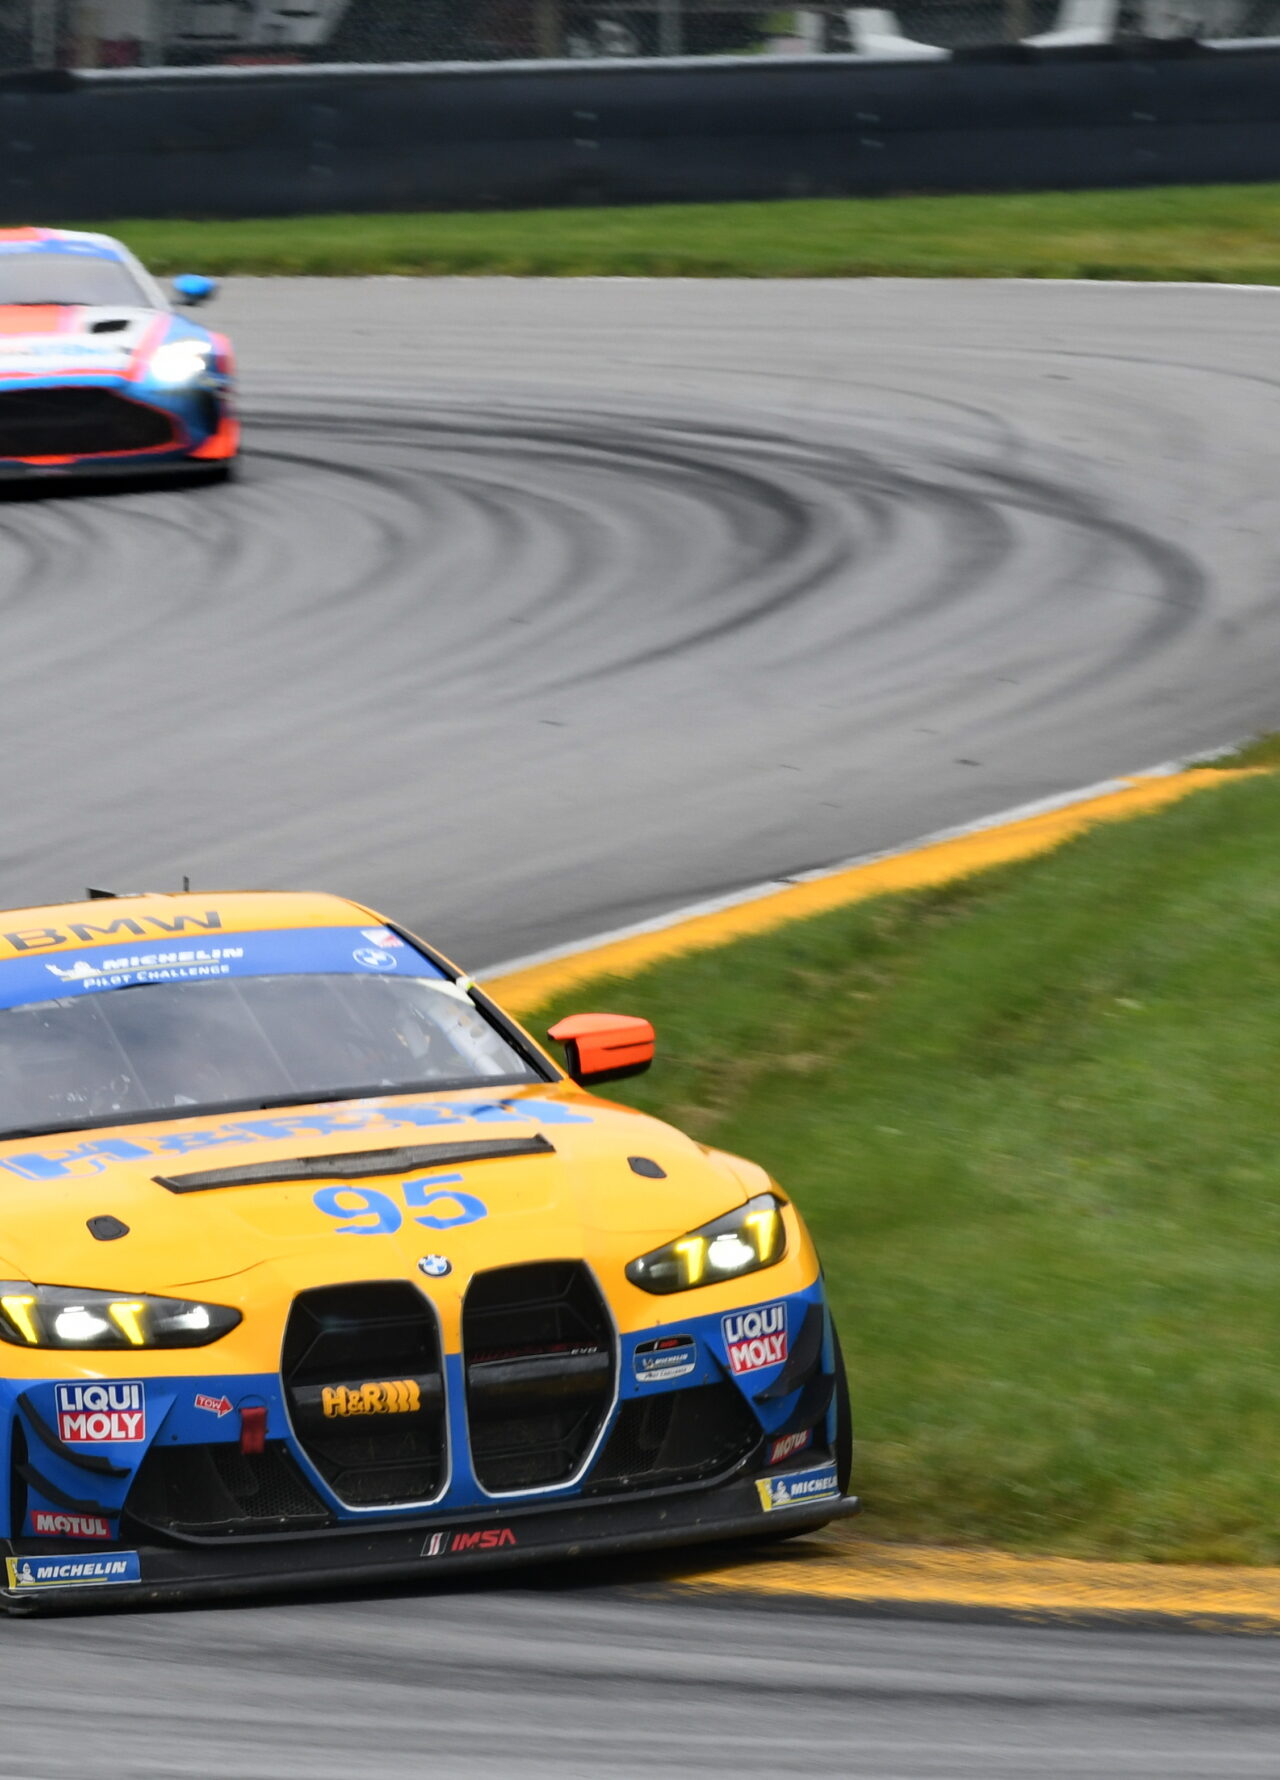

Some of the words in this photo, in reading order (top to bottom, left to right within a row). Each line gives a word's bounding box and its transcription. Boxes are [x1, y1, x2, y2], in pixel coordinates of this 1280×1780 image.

[4, 911, 222, 951] BMW
[102, 947, 243, 970] MICHELIN
[83, 974, 132, 989] PILOT
[136, 964, 230, 982] CHALLENGE
[313, 1173, 487, 1235] 95
[725, 1306, 784, 1344] LIQUI
[730, 1333, 786, 1371] MOLY
[60, 1384, 139, 1412] LIQUI
[200, 1396, 221, 1410] TOW
[63, 1413, 142, 1439] MOLY
[37, 1514, 106, 1535] MOTUL
[451, 1528, 517, 1552] IMSA
[37, 1561, 127, 1579] MICHELIN
